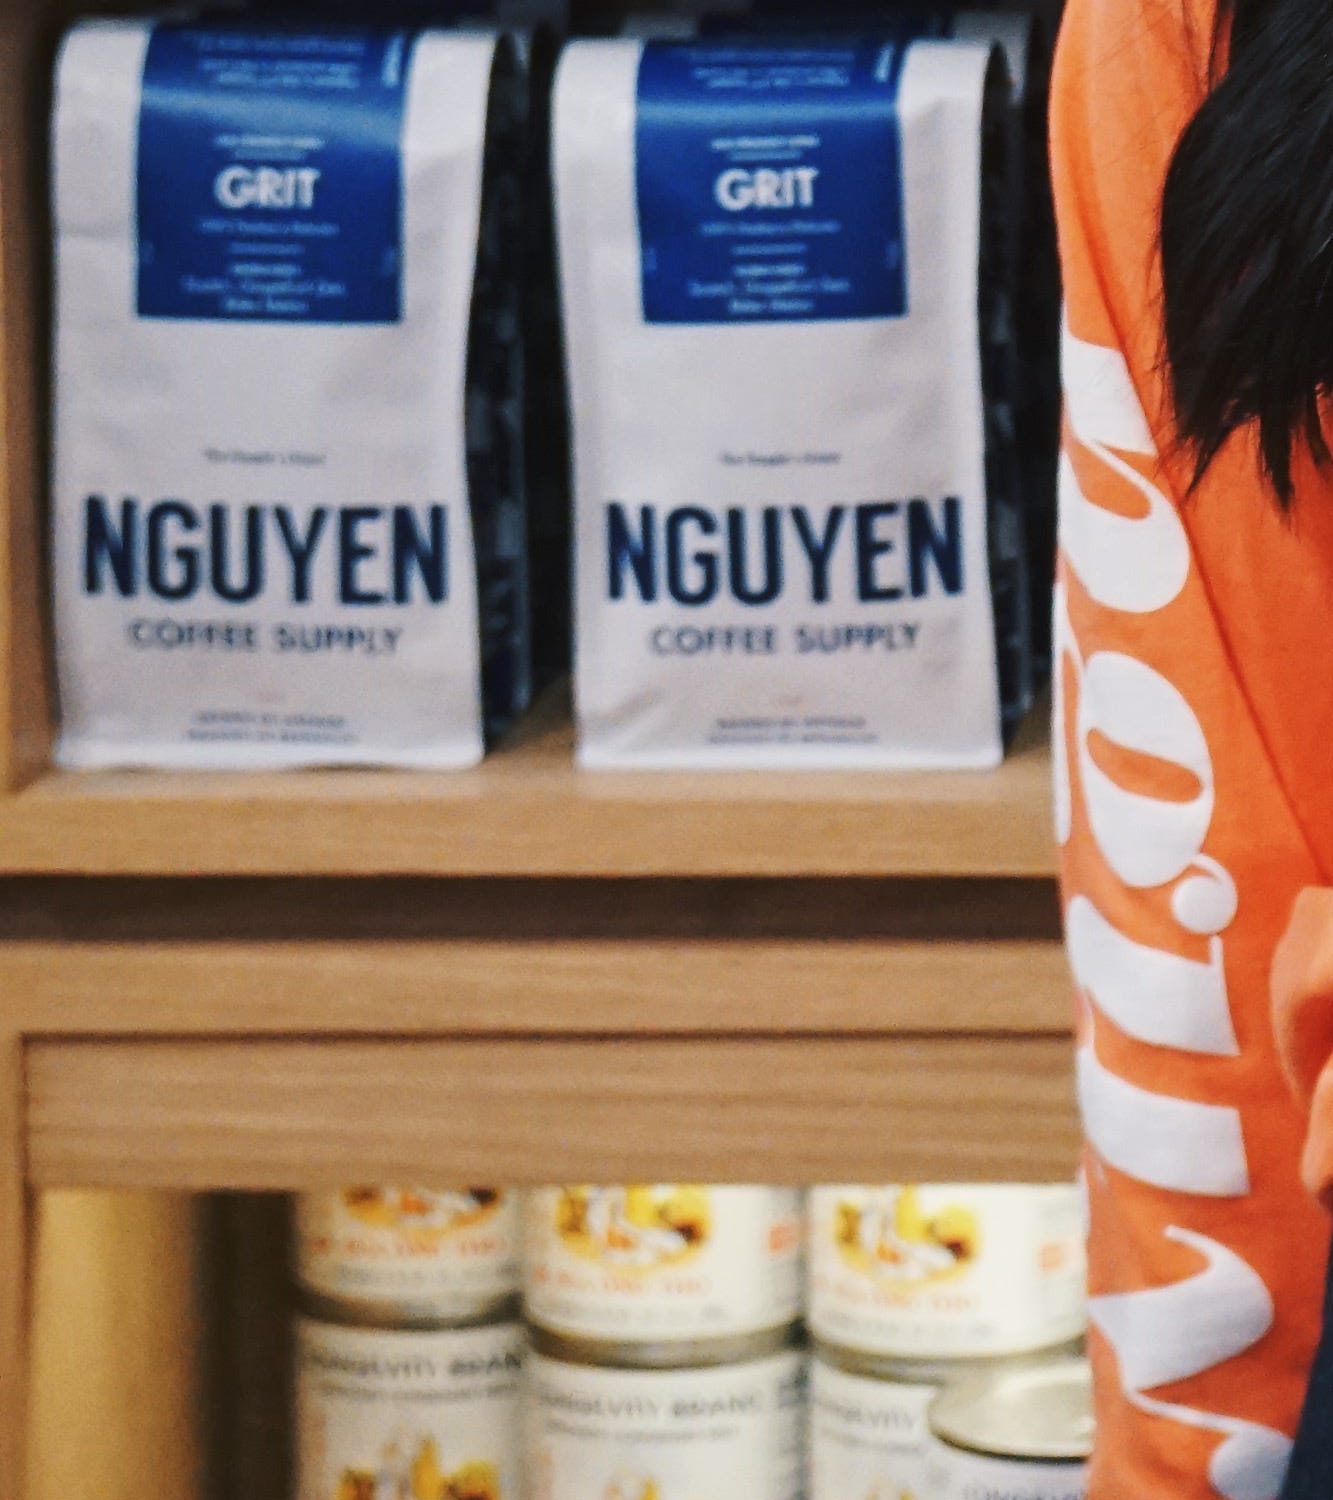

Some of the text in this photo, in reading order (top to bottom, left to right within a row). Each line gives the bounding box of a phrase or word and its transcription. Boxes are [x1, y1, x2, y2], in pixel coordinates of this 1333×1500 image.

[213, 166, 321, 210] GRIT
[714, 167, 819, 212] GRIT
[83, 493, 449, 606] NGUYEN
[605, 495, 964, 606] NGUYEN
[127, 618, 402, 655] COFFEE SUPPLY
[650, 622, 920, 656] COFFEE SUPPLY
